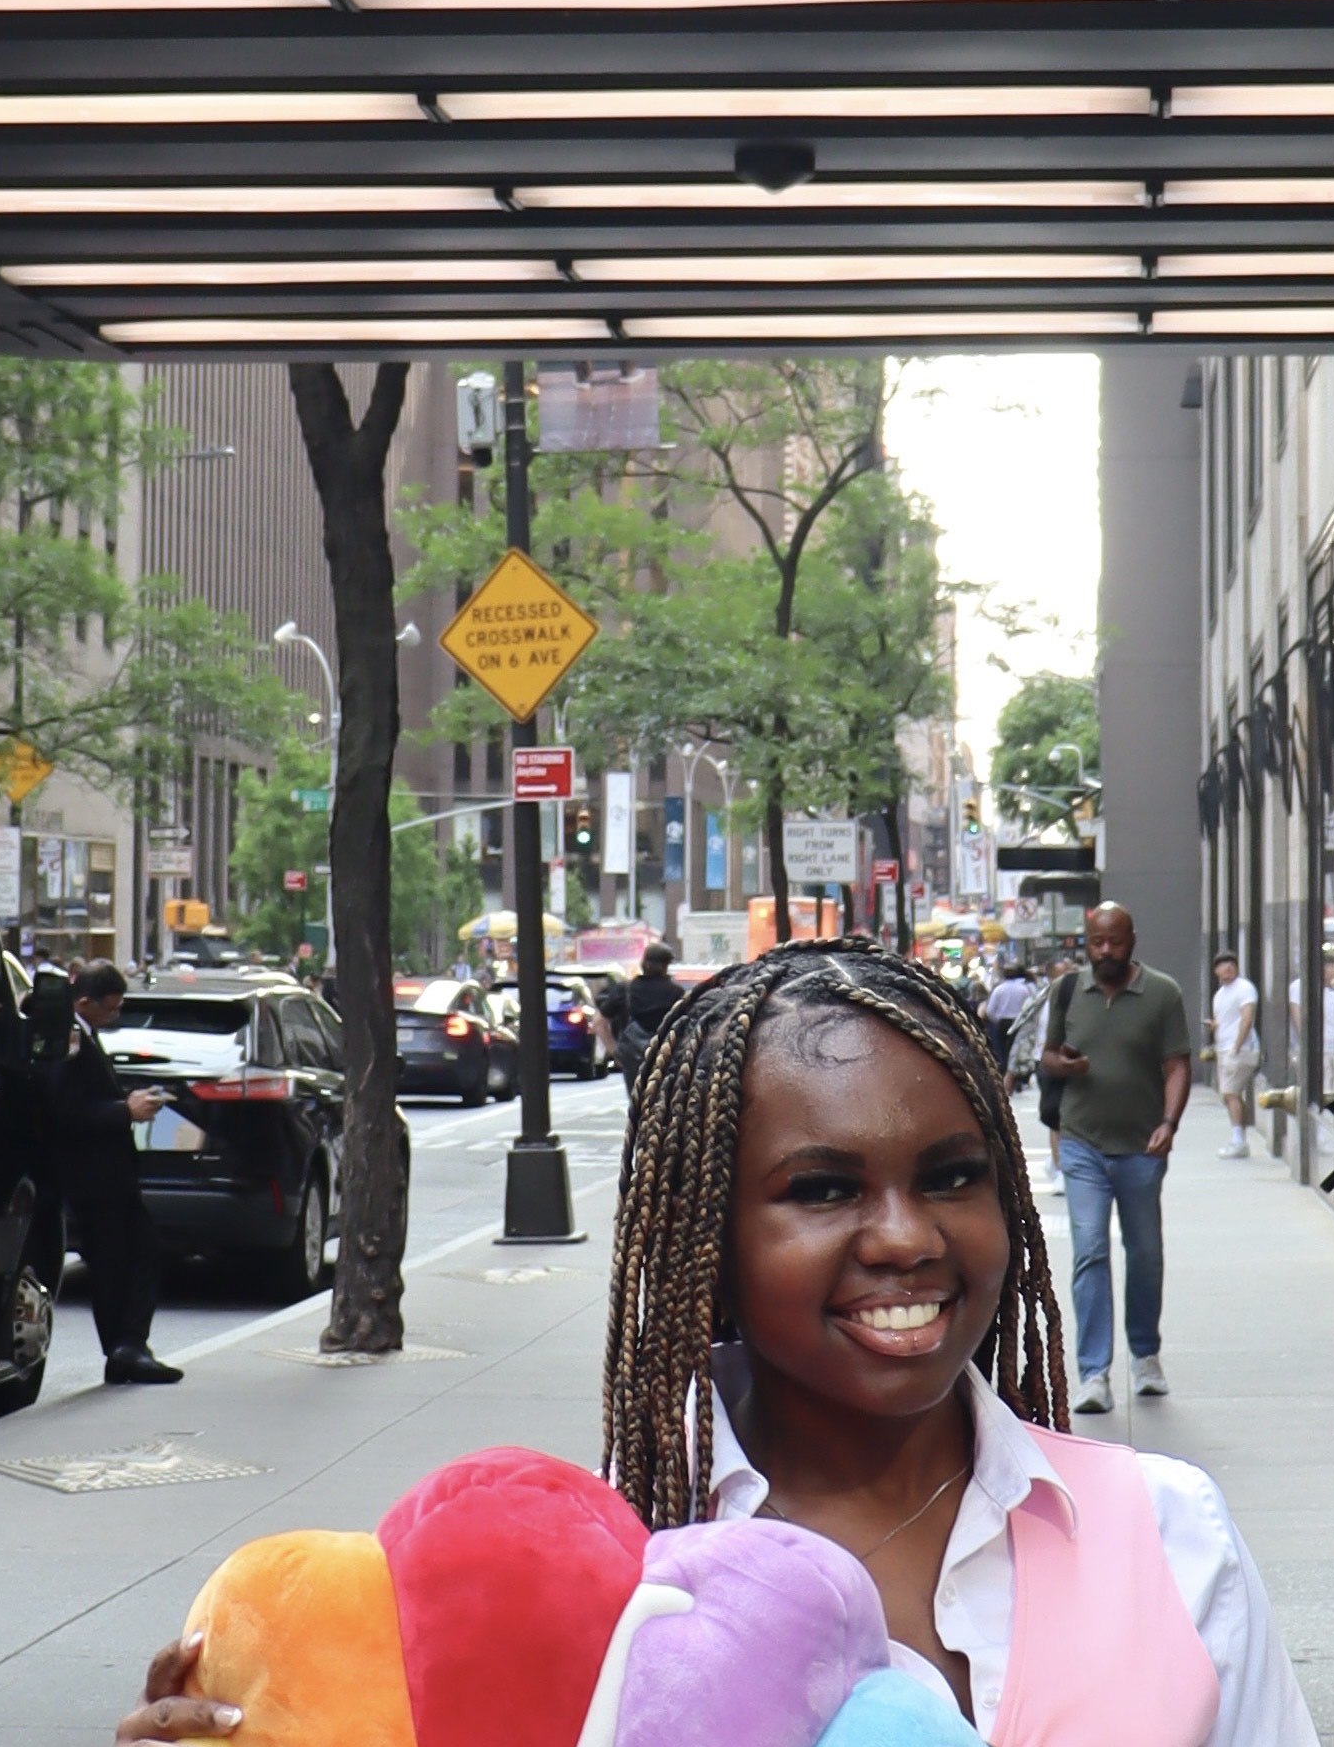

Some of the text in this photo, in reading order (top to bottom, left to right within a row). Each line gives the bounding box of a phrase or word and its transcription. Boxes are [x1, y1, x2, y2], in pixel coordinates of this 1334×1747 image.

[472, 602, 562, 623] RECESSED
[466, 624, 571, 648] CROSSWALK
[478, 648, 562, 670] ON 6 AVE
[786, 826, 852, 839] RIGHT TURNS
[787, 853, 851, 866] RIGHT LANE
[806, 867, 833, 878] ONLY
